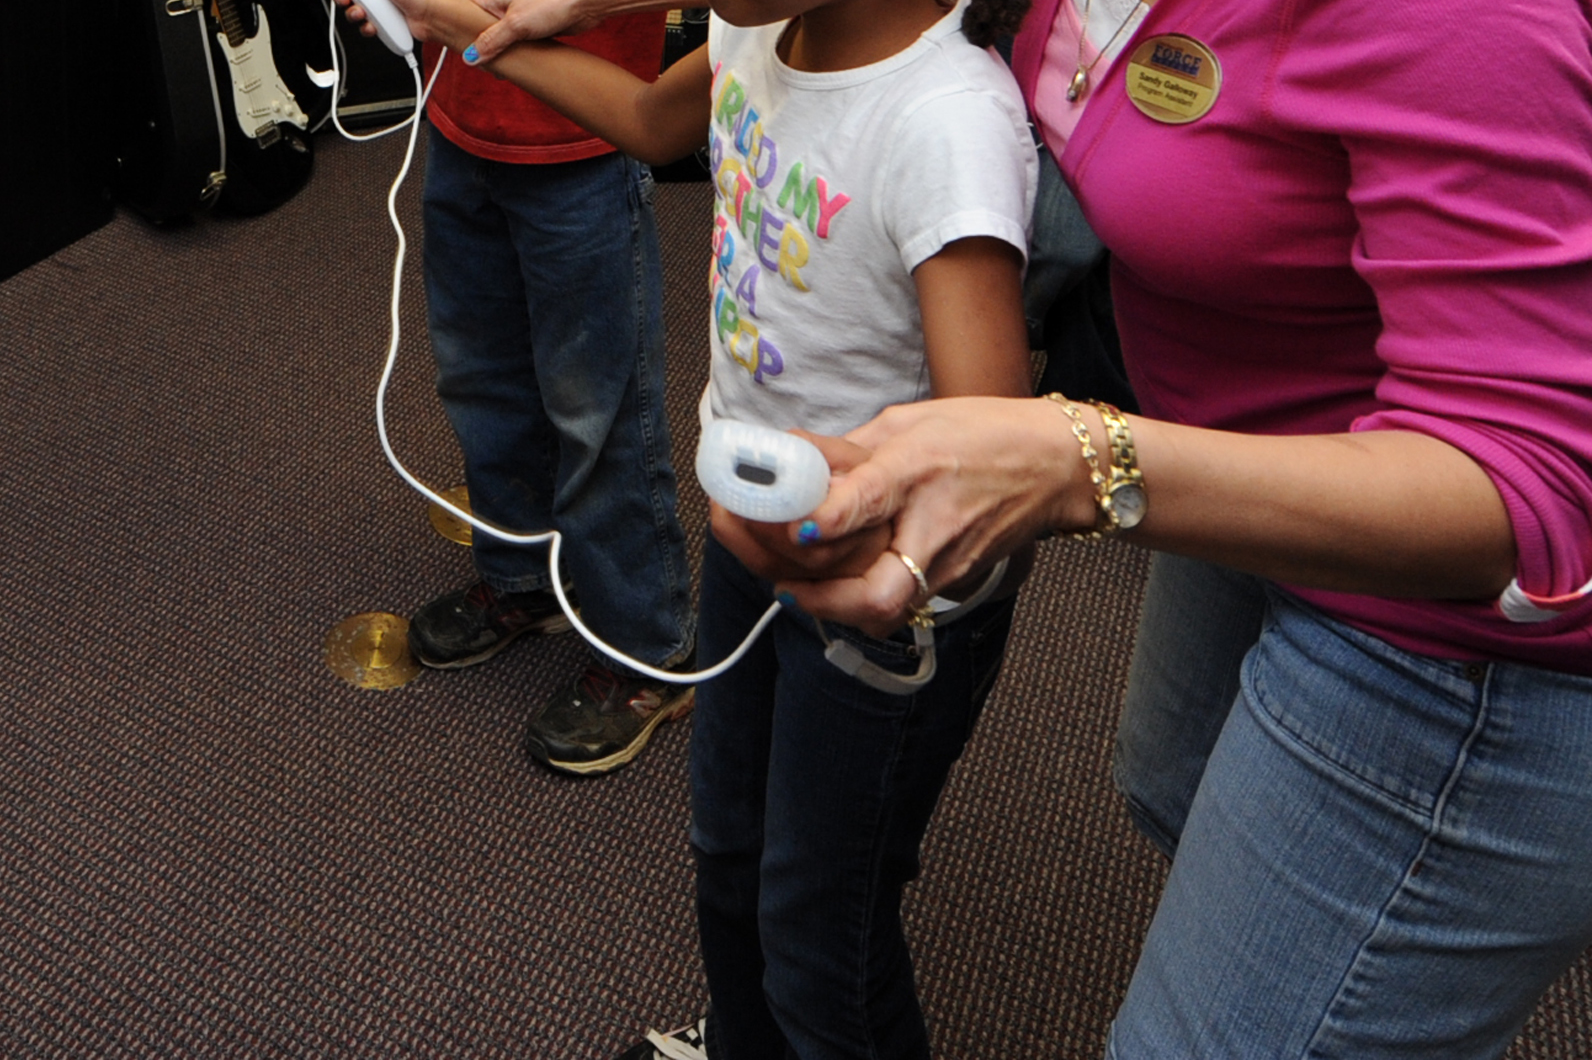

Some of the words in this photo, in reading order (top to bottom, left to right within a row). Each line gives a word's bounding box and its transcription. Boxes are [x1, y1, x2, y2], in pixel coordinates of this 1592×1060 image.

[1155, 43, 1203, 67] FORCE
[709, 125, 810, 293] ROTHER
[776, 161, 852, 239] MY
[735, 263, 760, 319] A
